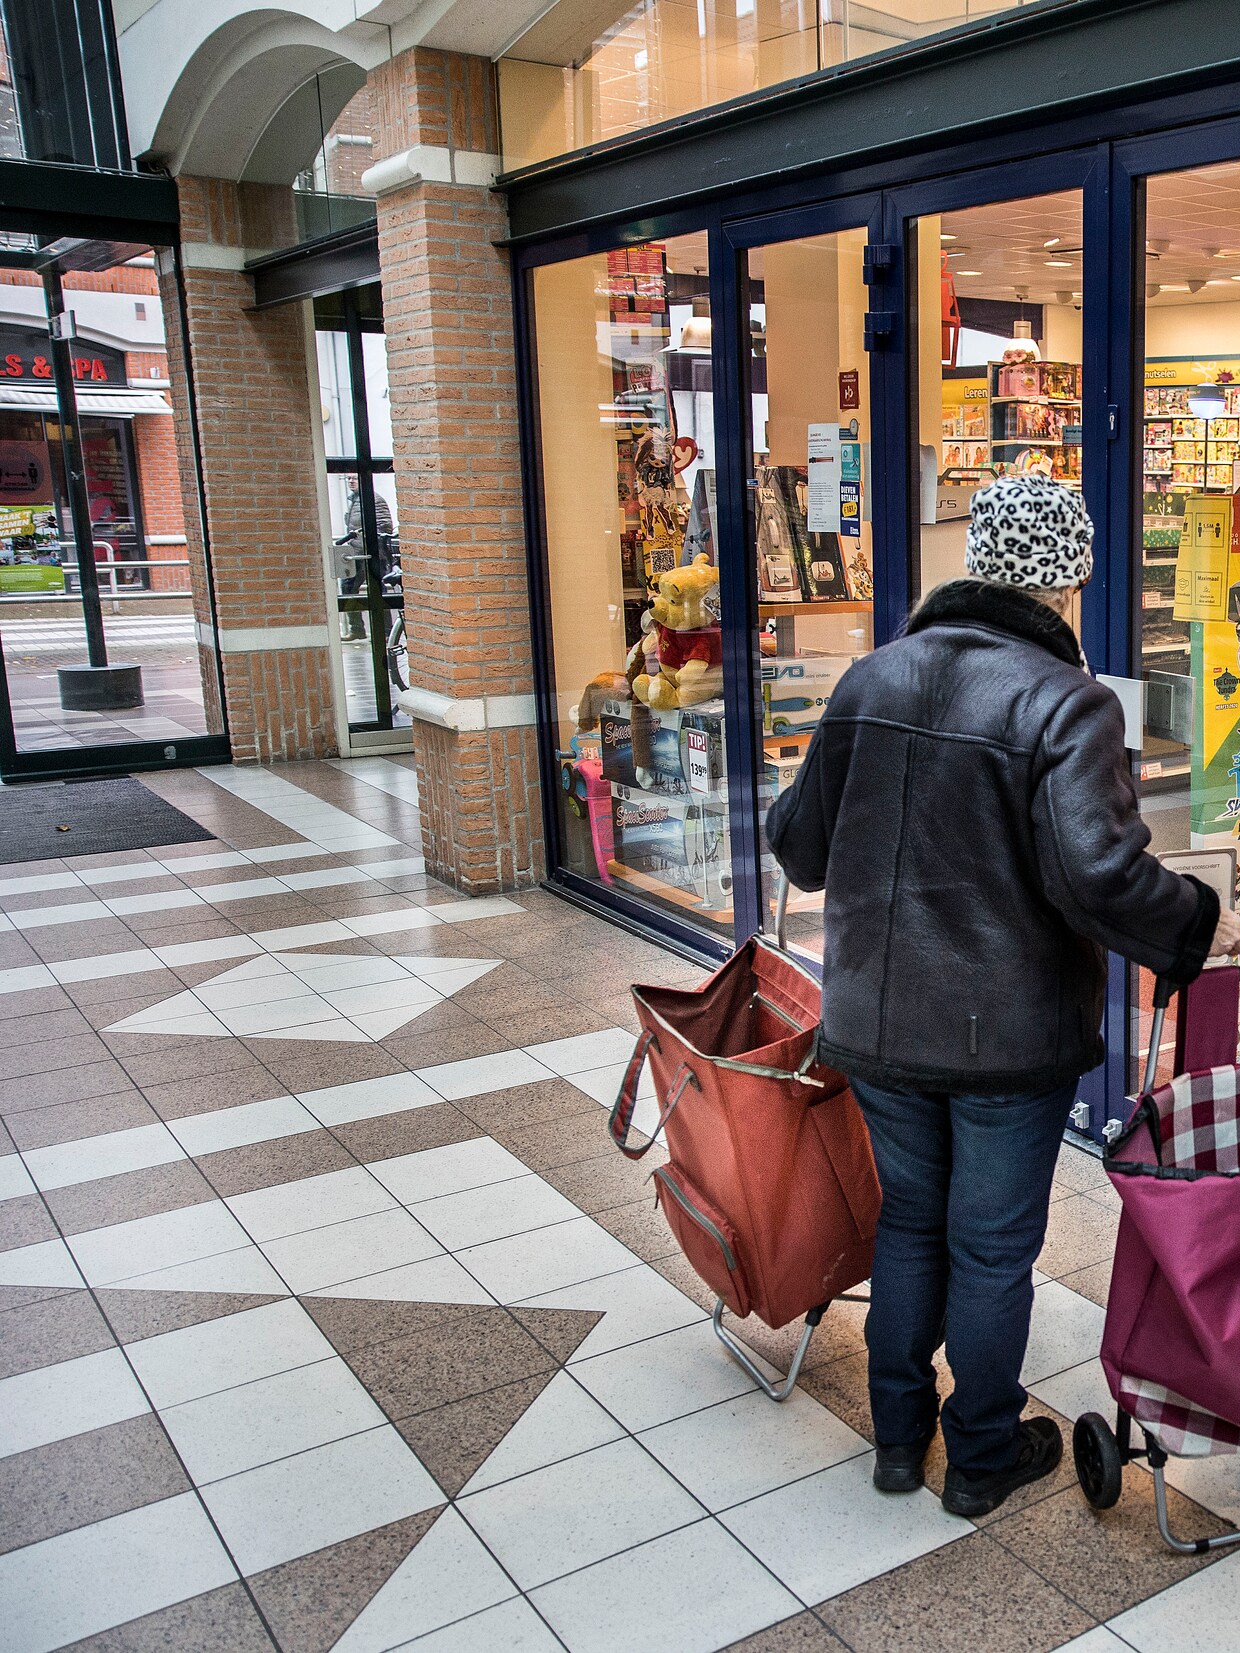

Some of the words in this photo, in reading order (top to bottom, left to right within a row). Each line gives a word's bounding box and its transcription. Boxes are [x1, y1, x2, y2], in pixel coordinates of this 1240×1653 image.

[0, 354, 24, 378] S
[32, 355, 52, 378] &
[71, 357, 108, 380] PA
[964, 386, 988, 399] Leren
[936, 499, 957, 509] S5
[688, 733, 706, 750] TIP!
